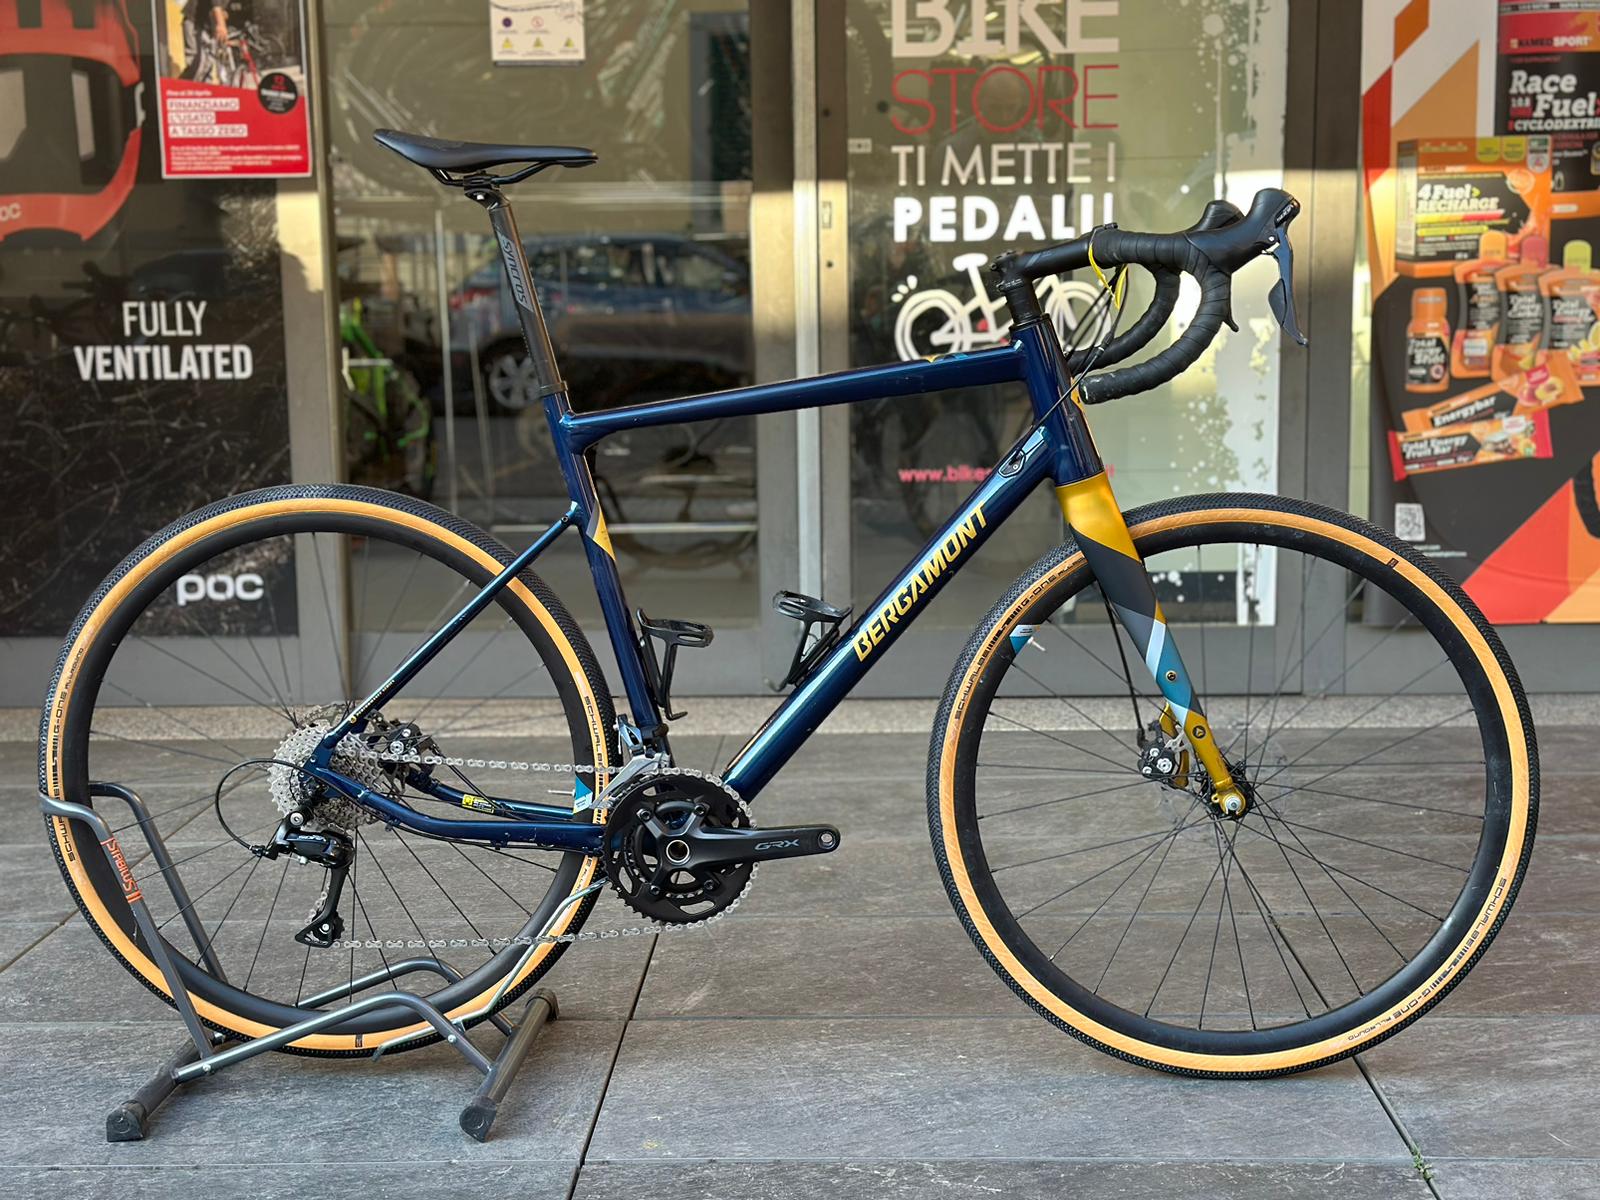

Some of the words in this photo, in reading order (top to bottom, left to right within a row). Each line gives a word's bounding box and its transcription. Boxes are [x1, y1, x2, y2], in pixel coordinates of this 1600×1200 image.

[891, 0, 1120, 58] BIKE
[1509, 69, 1577, 94] Race
[168, 100, 238, 111] FINANZIAMO
[891, 64, 1120, 135] STORE
[1532, 91, 1596, 117] Fuel
[170, 112, 215, 123] L'USATO
[182, 126, 216, 136] TASSO
[218, 126, 246, 136] ZERO
[892, 145, 926, 186] TI
[941, 142, 1092, 186] METTE
[1107, 142, 1116, 183] I
[1417, 196, 1500, 213] RECHARGE
[122, 301, 208, 337] FULLY
[73, 344, 254, 381] VENTILATED
[1433, 396, 1497, 428] Energybar
[853, 499, 988, 662] BERGAMONT
[754, 838, 800, 851] GRX
